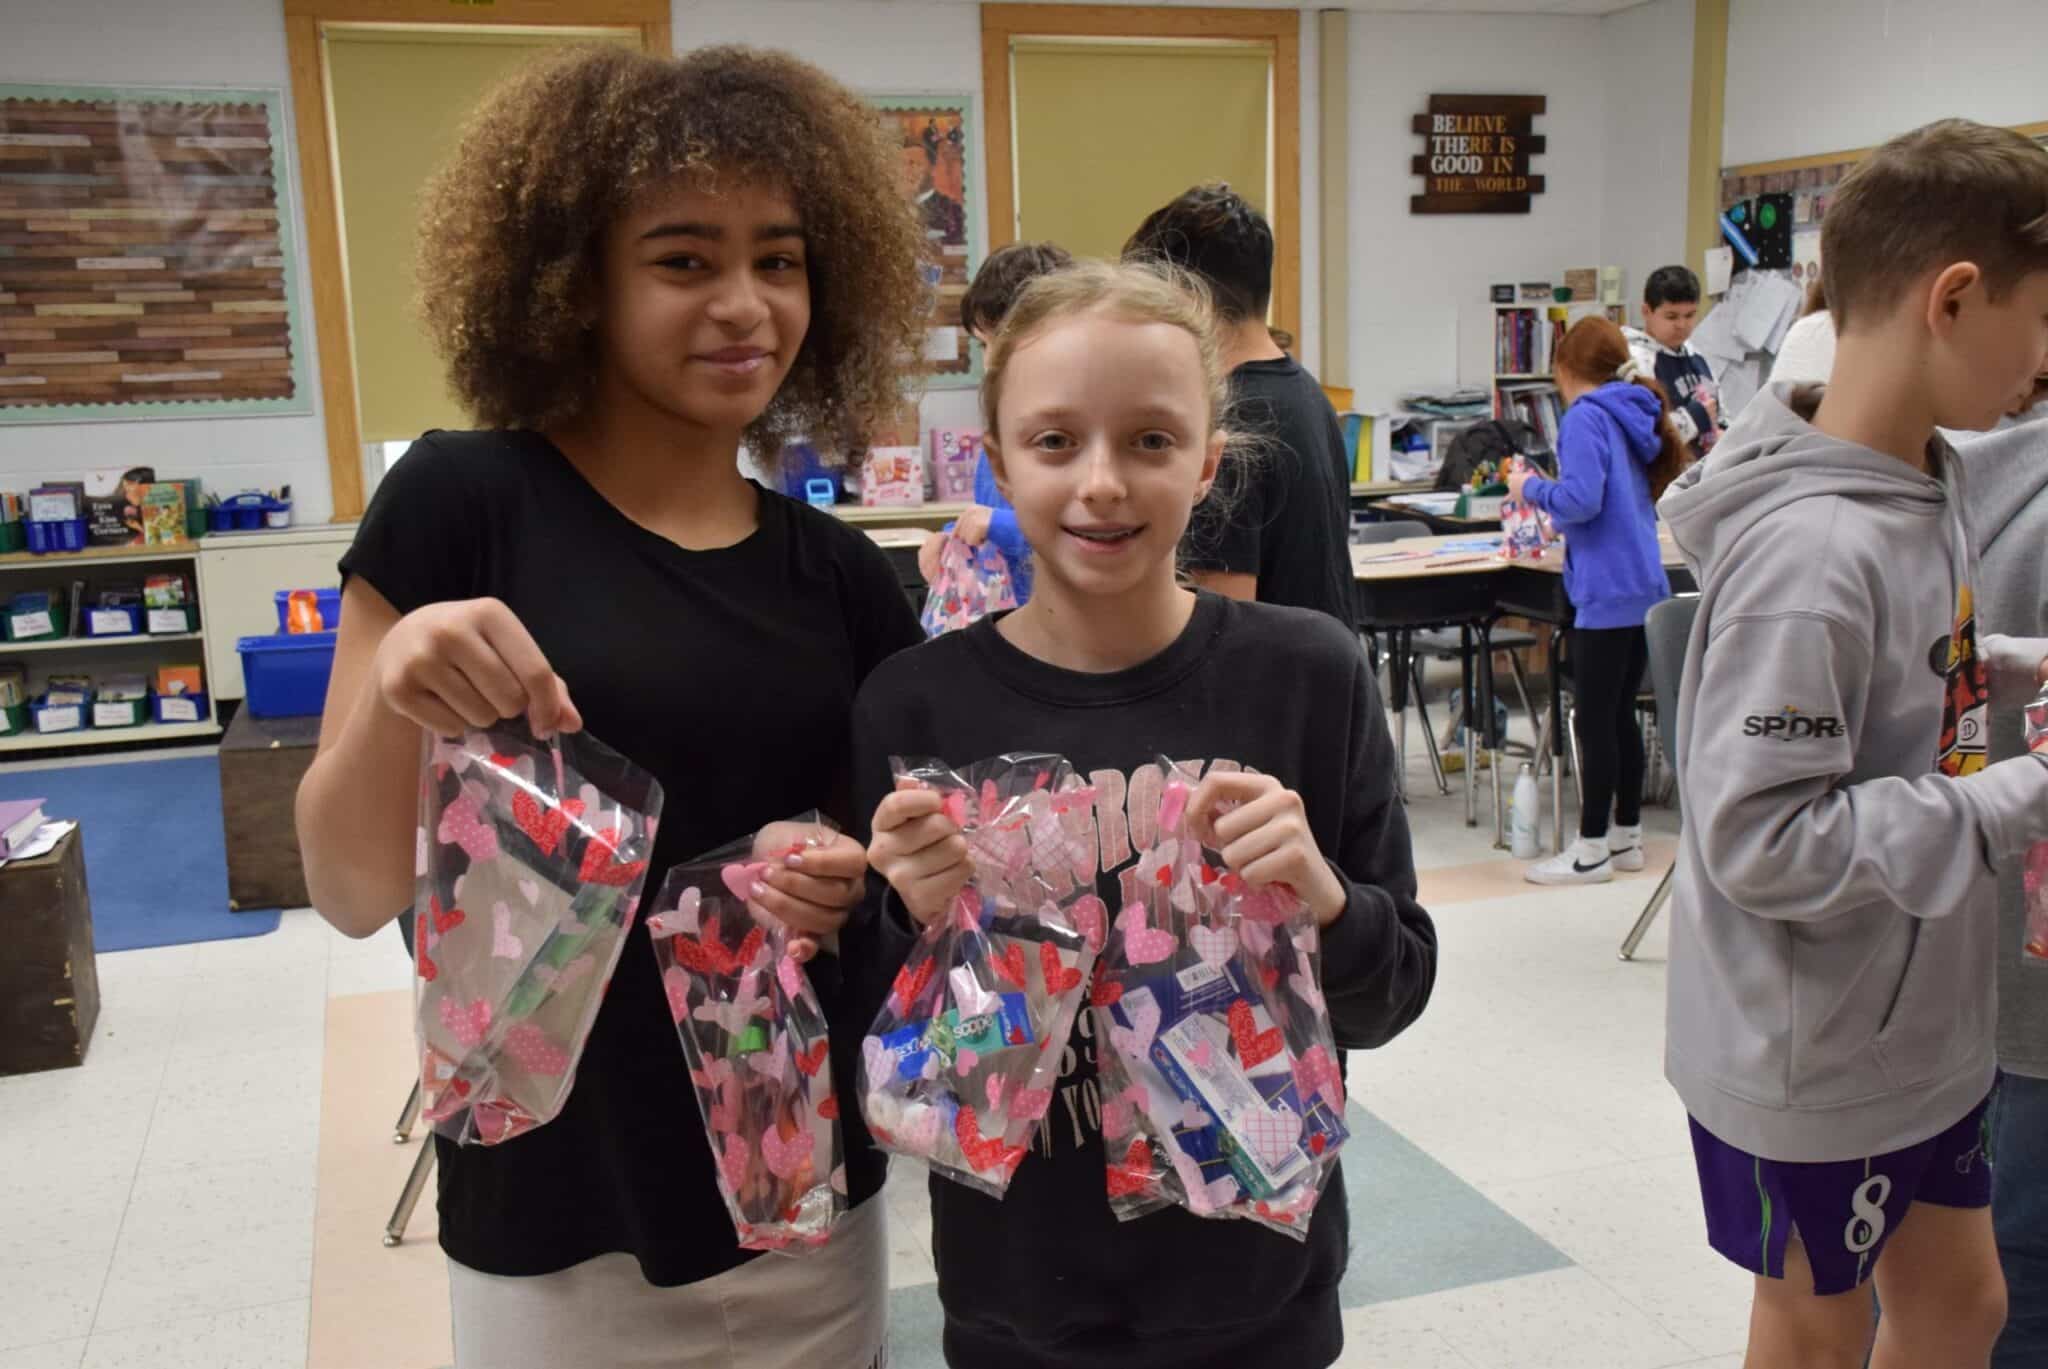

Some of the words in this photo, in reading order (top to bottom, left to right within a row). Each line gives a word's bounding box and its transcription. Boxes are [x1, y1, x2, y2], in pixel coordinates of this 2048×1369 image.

[1433, 115, 1507, 134] BELIEVE
[1432, 136, 1493, 154] THERE
[1501, 136, 1516, 154] IS
[1431, 155, 1484, 174] GOOD
[1493, 155, 1513, 174] IN
[1436, 177, 1465, 193] THE
[1475, 177, 1528, 192] WORLD
[1844, 1174, 1891, 1253] 8
